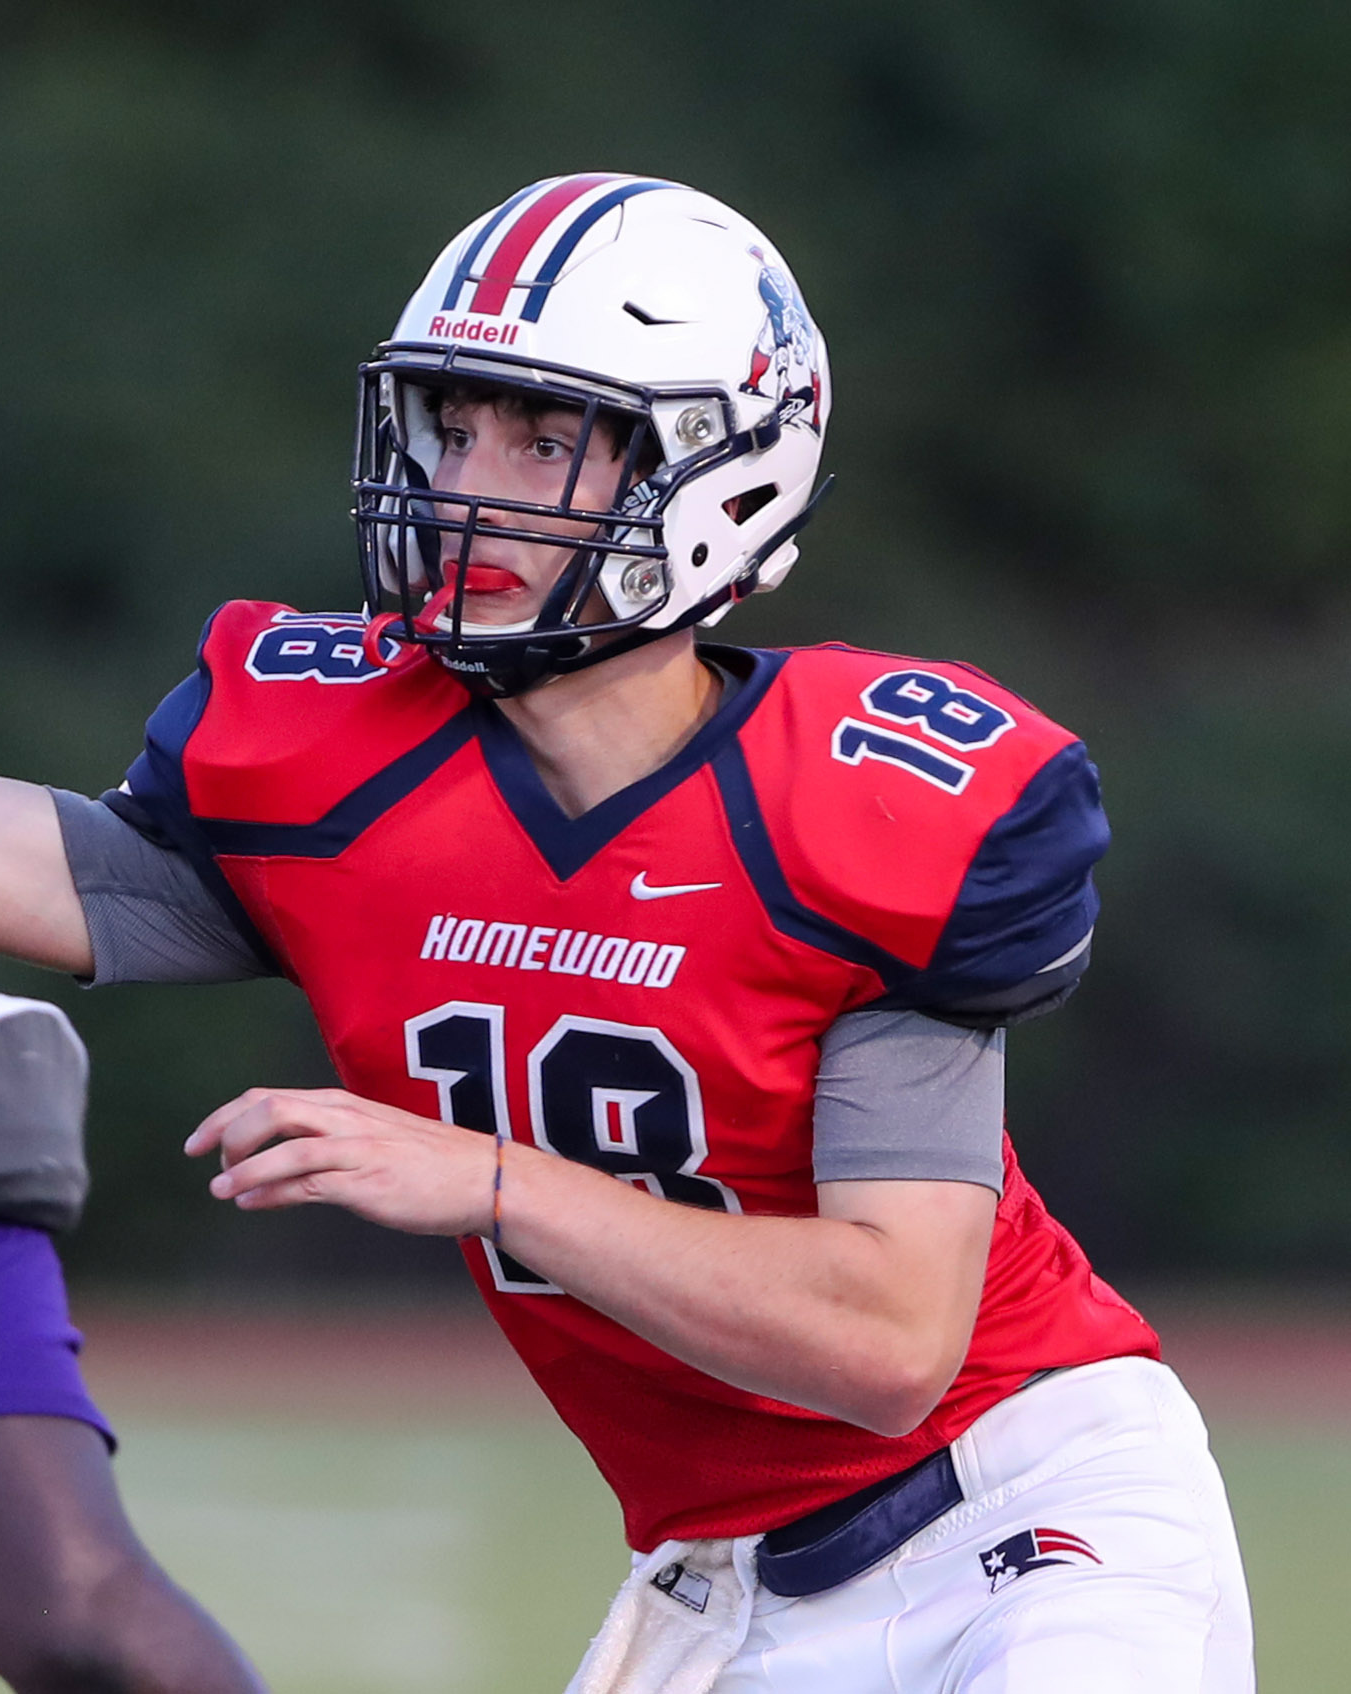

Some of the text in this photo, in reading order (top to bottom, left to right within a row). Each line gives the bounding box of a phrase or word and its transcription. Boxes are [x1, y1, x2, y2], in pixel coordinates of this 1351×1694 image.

[428, 316, 519, 345] Riddell
[831, 669, 1018, 796] 18
[419, 914, 687, 989] HOMEWOOD
[404, 1000, 744, 1295] 18
